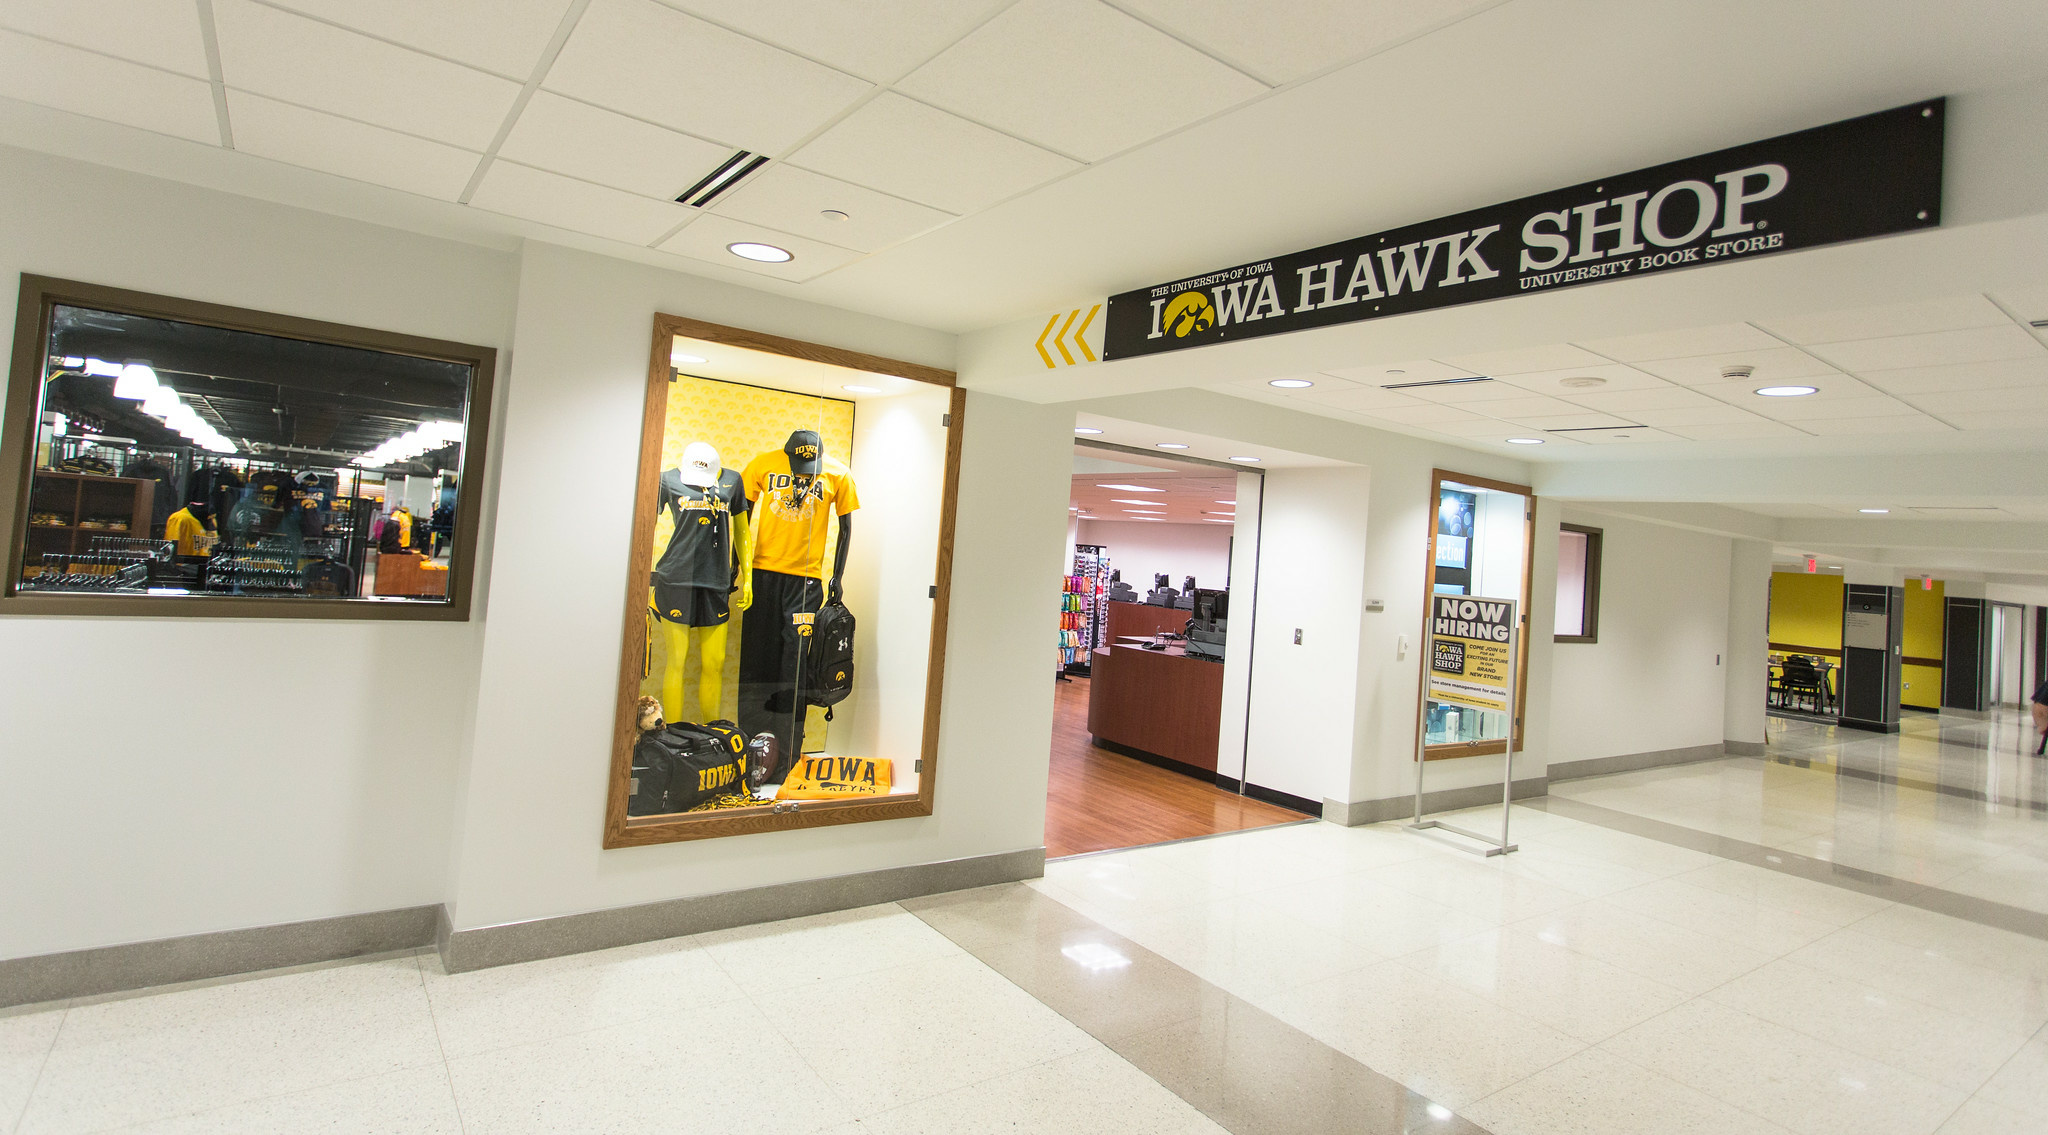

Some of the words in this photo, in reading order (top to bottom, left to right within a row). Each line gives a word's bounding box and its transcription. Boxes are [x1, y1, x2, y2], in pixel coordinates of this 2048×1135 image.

[1293, 224, 1501, 314] HAWK
[1519, 163, 1790, 273] SHOP
[1519, 259, 1635, 290] UNIVERSITY
[1638, 247, 1700, 271] BOOK
[1704, 232, 1784, 260] STORE
[1151, 288, 1169, 298] THE
[1171, 272, 1227, 293] UNIVERSITY
[1230, 269, 1244, 280] OF
[1246, 262, 1274, 277] IOWA
[768, 473, 824, 502] IOWA
[1441, 599, 1506, 623] NOW
[1435, 618, 1509, 642] HIRING
[1435, 652, 1463, 663] HAWK
[1435, 660, 1462, 670] SHOP
[1466, 654, 1488, 662] EXCITING
[1452, 683, 1482, 692] management
[804, 756, 876, 786] IOWA
